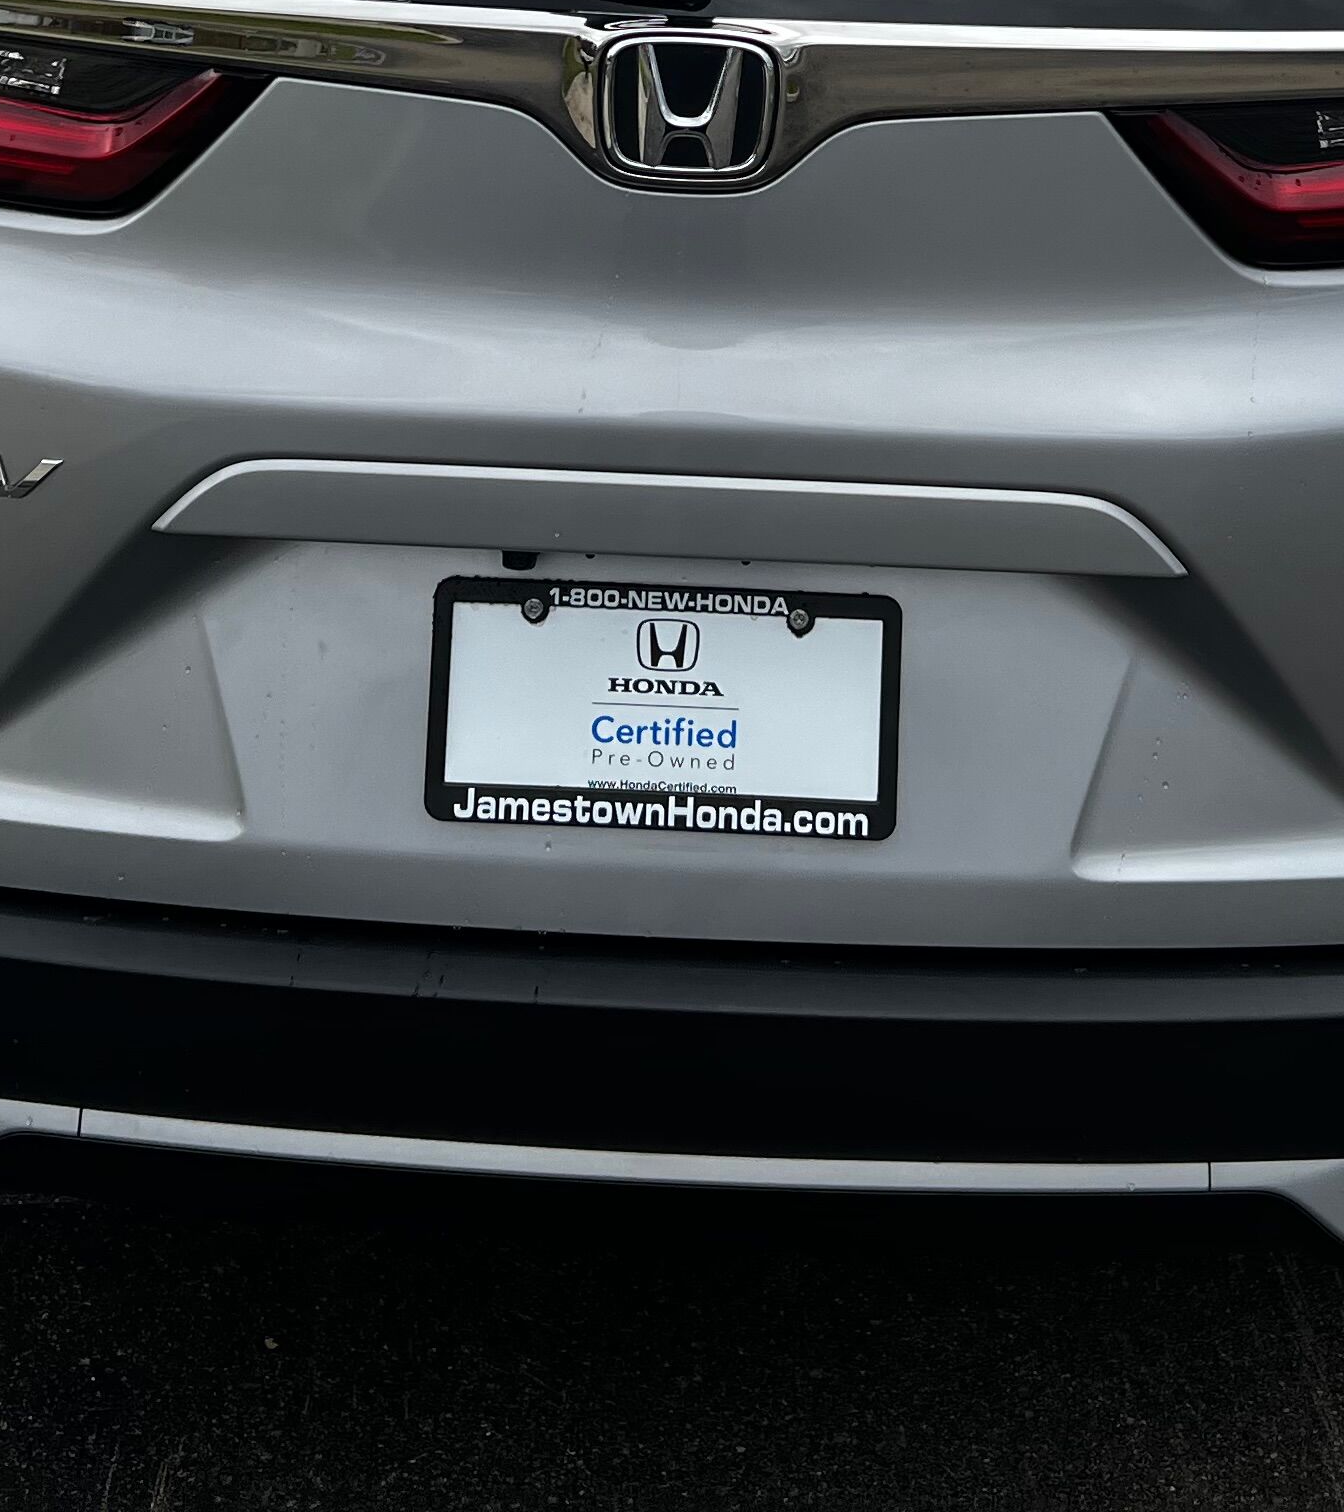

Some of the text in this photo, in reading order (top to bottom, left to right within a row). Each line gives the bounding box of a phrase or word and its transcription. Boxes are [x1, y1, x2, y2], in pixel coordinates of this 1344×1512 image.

[549, 587, 789, 616] 1-800-NEW-HONDA
[608, 677, 724, 697] HONDA
[591, 715, 737, 749] Certified
[591, 749, 736, 771] Pre-Owned
[587, 779, 737, 794] www.HondaCertified.com
[453, 788, 869, 836] JamestownHonda.com
